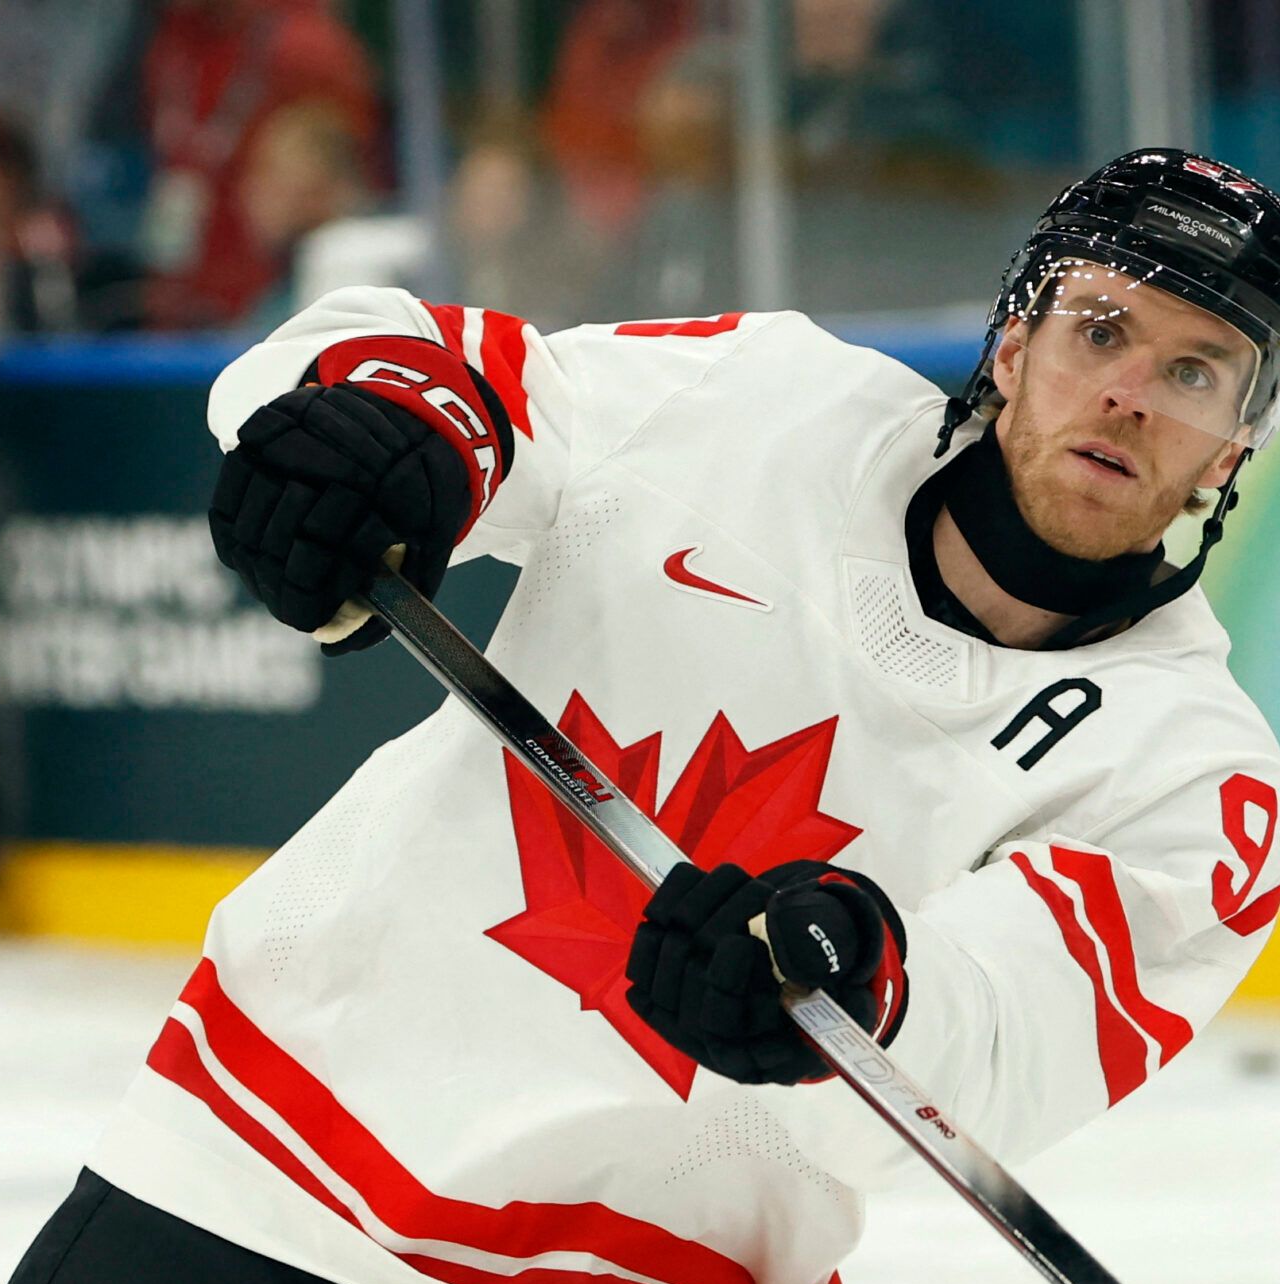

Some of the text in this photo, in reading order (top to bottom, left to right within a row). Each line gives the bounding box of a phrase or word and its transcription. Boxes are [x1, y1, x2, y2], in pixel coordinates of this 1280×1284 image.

[1147, 204, 1233, 248] MILANO CORTINA
[1177, 222, 1199, 237] 2026
[990, 677, 1103, 772] A
[525, 738, 598, 810] COMPOSITE
[807, 922, 840, 973] CCM
[931, 1117, 956, 1140] PRO
